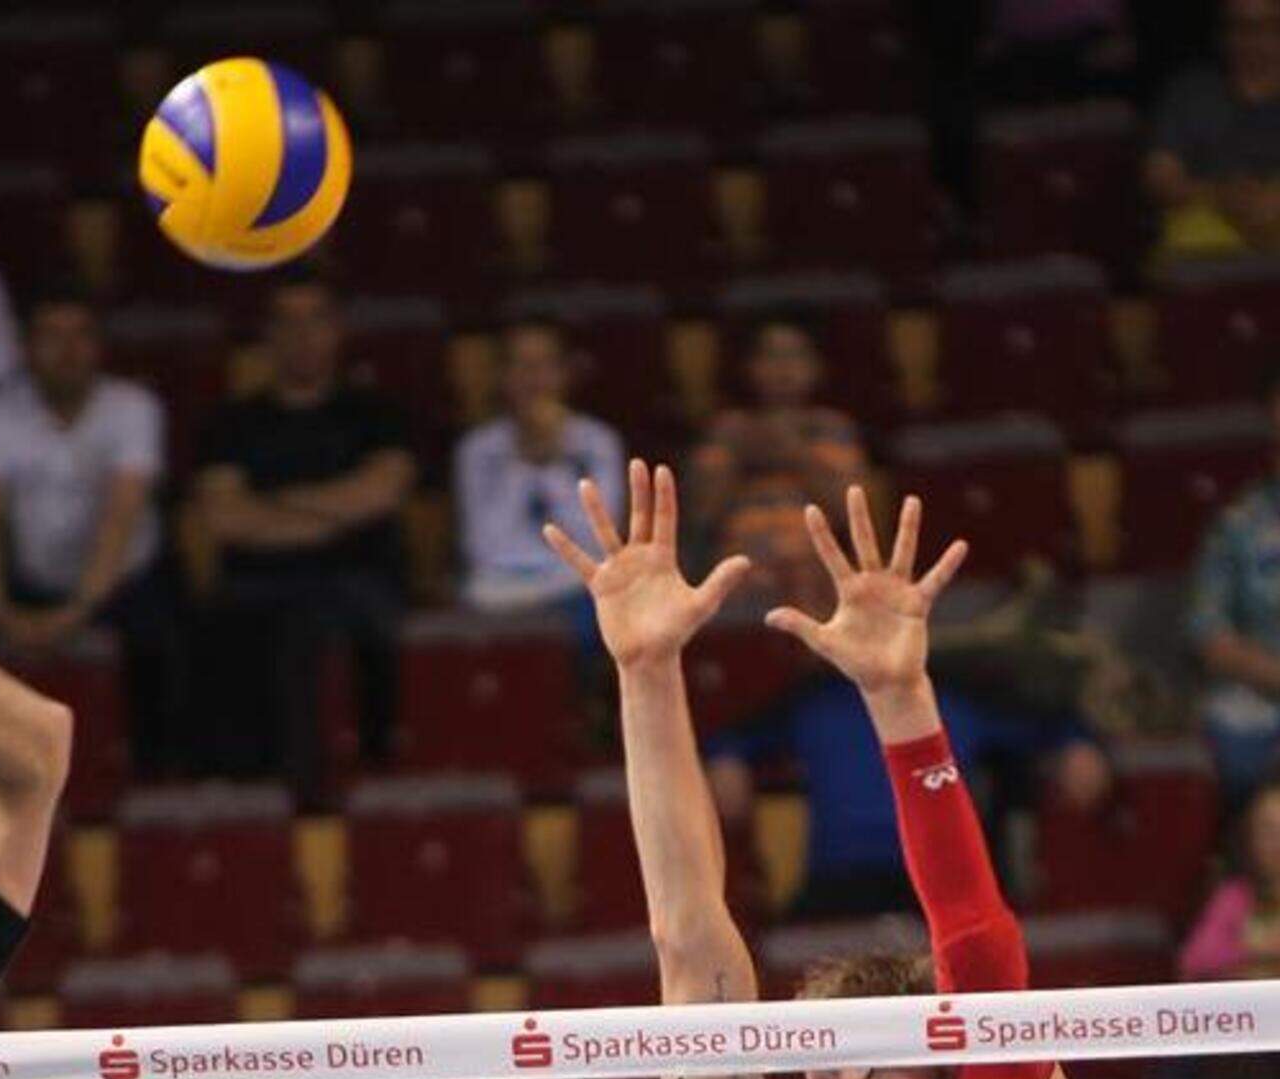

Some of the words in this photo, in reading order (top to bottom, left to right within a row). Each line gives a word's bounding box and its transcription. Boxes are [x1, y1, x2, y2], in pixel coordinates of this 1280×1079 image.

[562, 1029, 726, 1063] Sparkasse
[739, 1023, 837, 1055] Düren
[976, 1011, 1143, 1045] Sparkasse
[1156, 1005, 1254, 1038] Düren
[150, 1043, 314, 1078] Sparkasse
[327, 1040, 424, 1070] Düren
